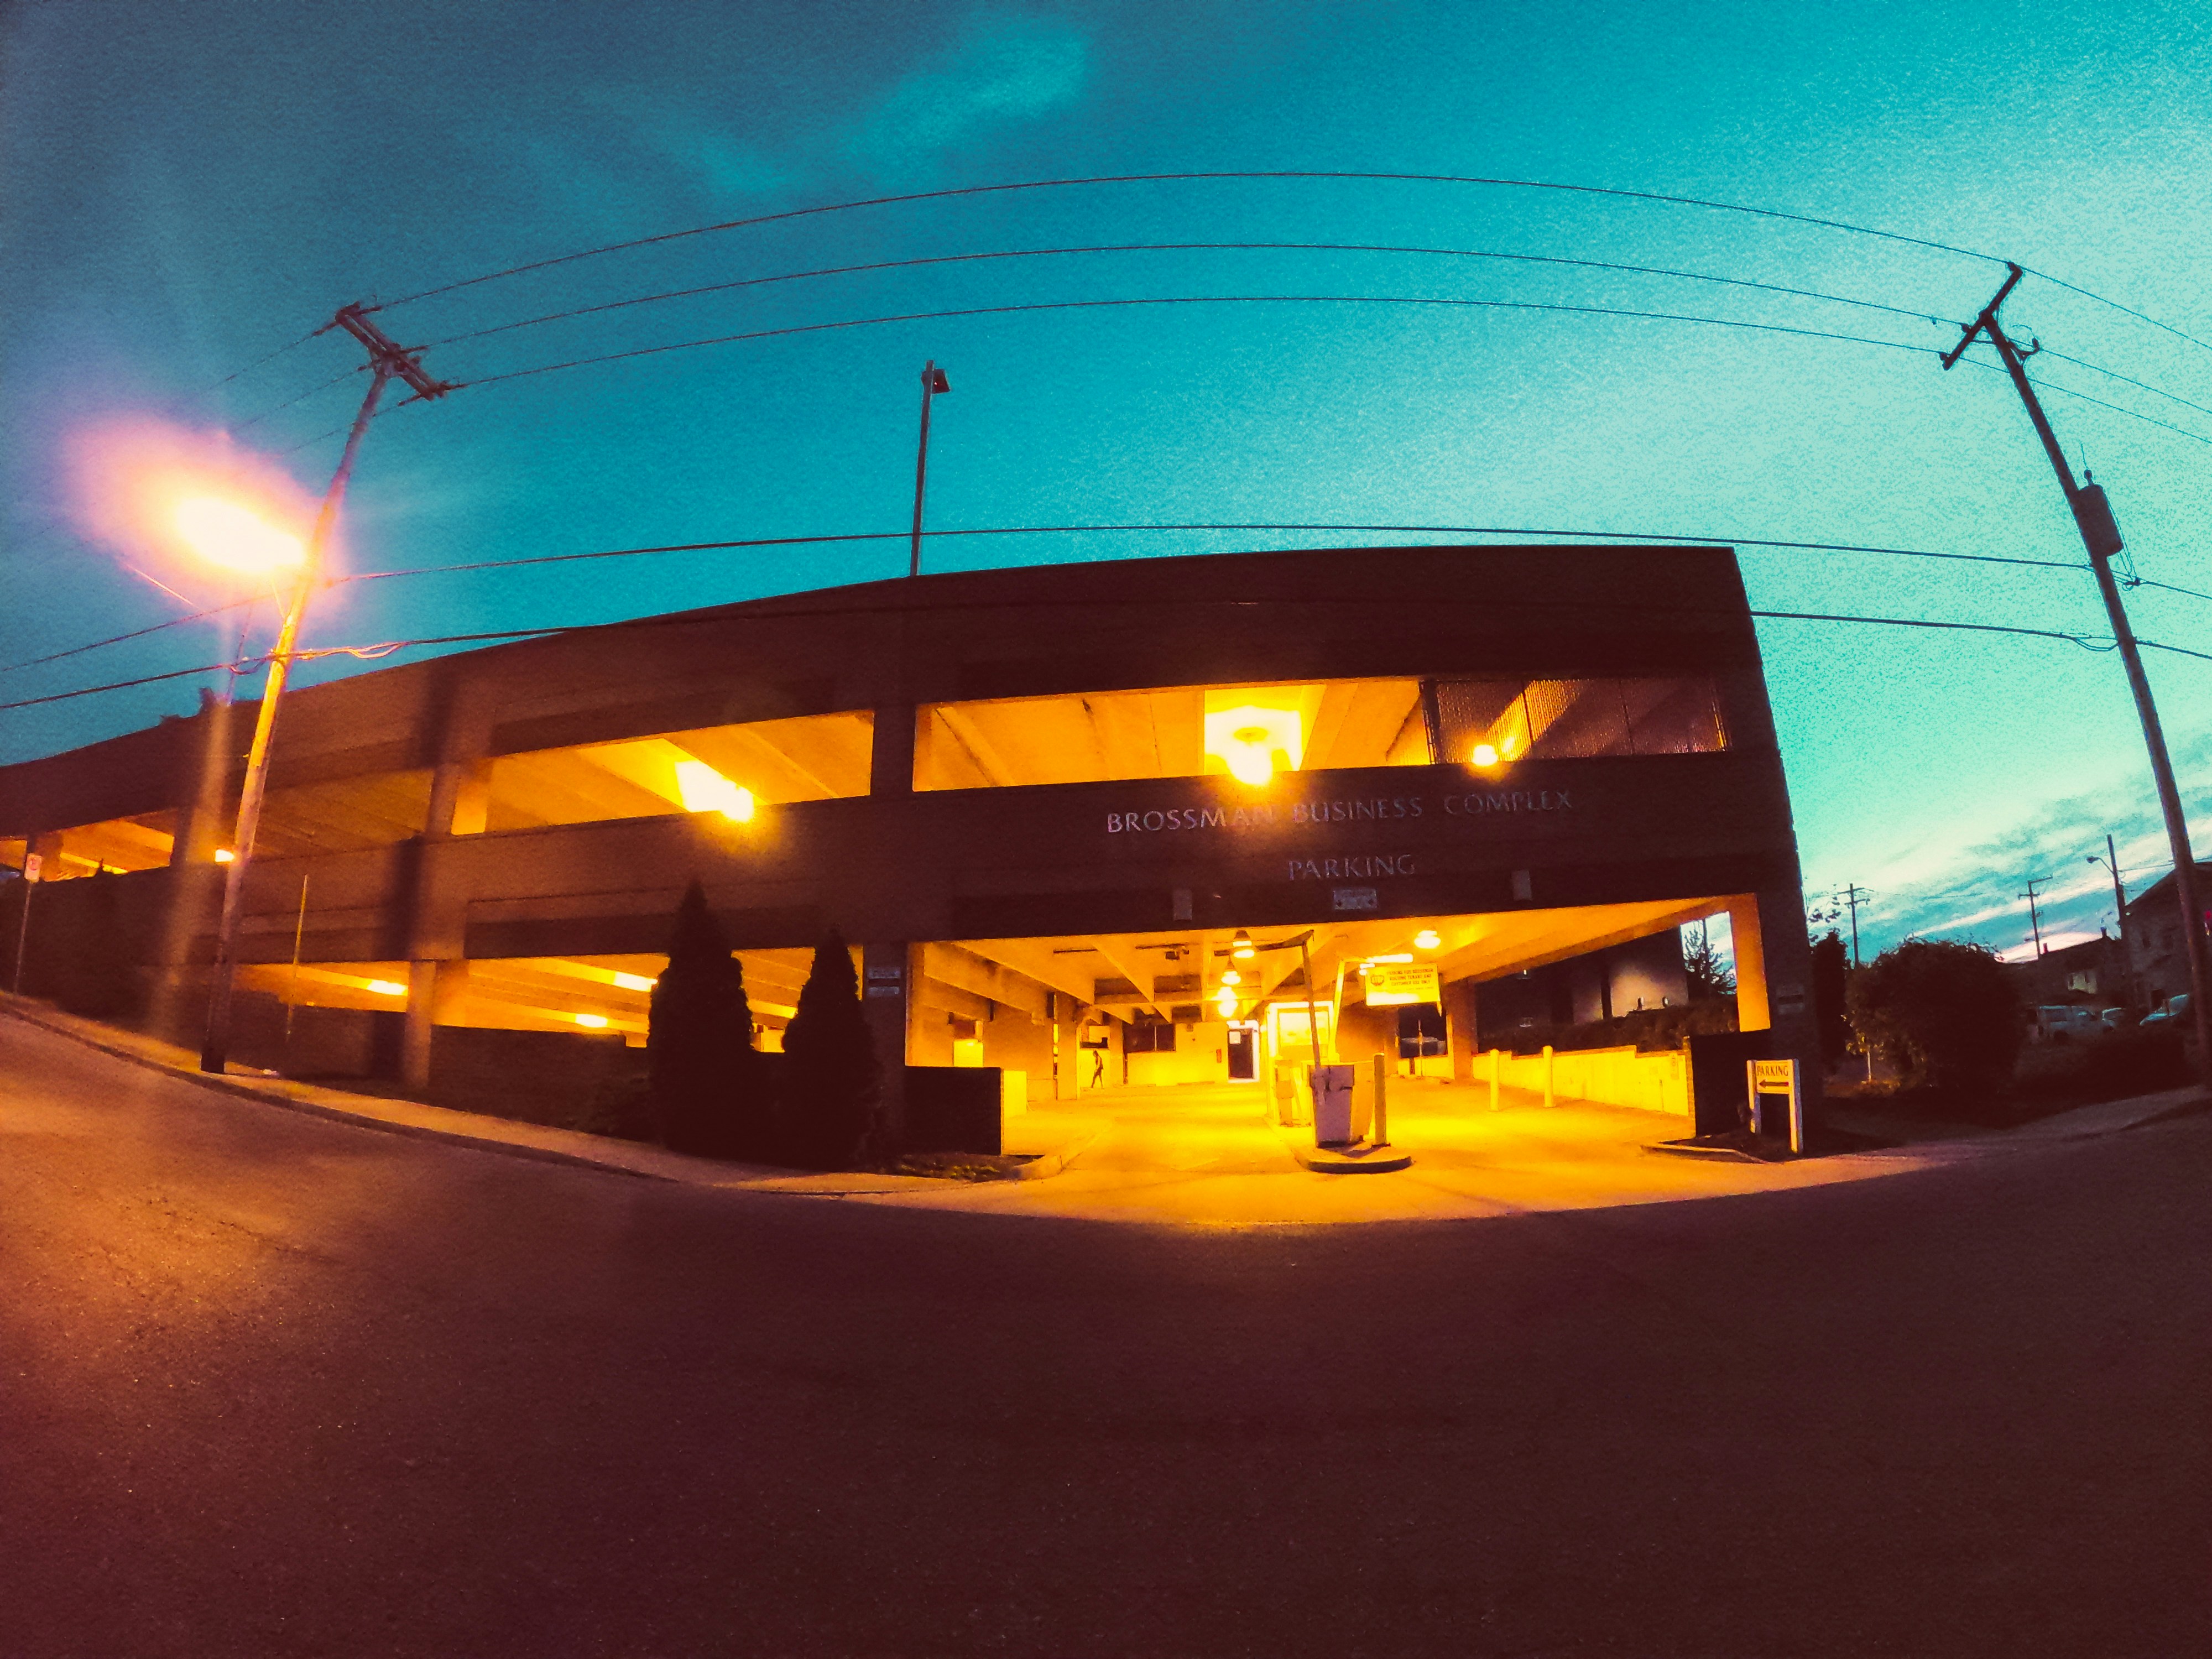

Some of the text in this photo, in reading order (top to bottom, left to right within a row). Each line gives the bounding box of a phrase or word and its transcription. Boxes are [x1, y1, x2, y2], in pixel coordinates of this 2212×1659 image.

[1108, 790, 1573, 832] BROSSMAN BUSINESS COMPLEX
[1288, 854, 1416, 881] PARKING
[1756, 1065, 1788, 1076] PARKING
